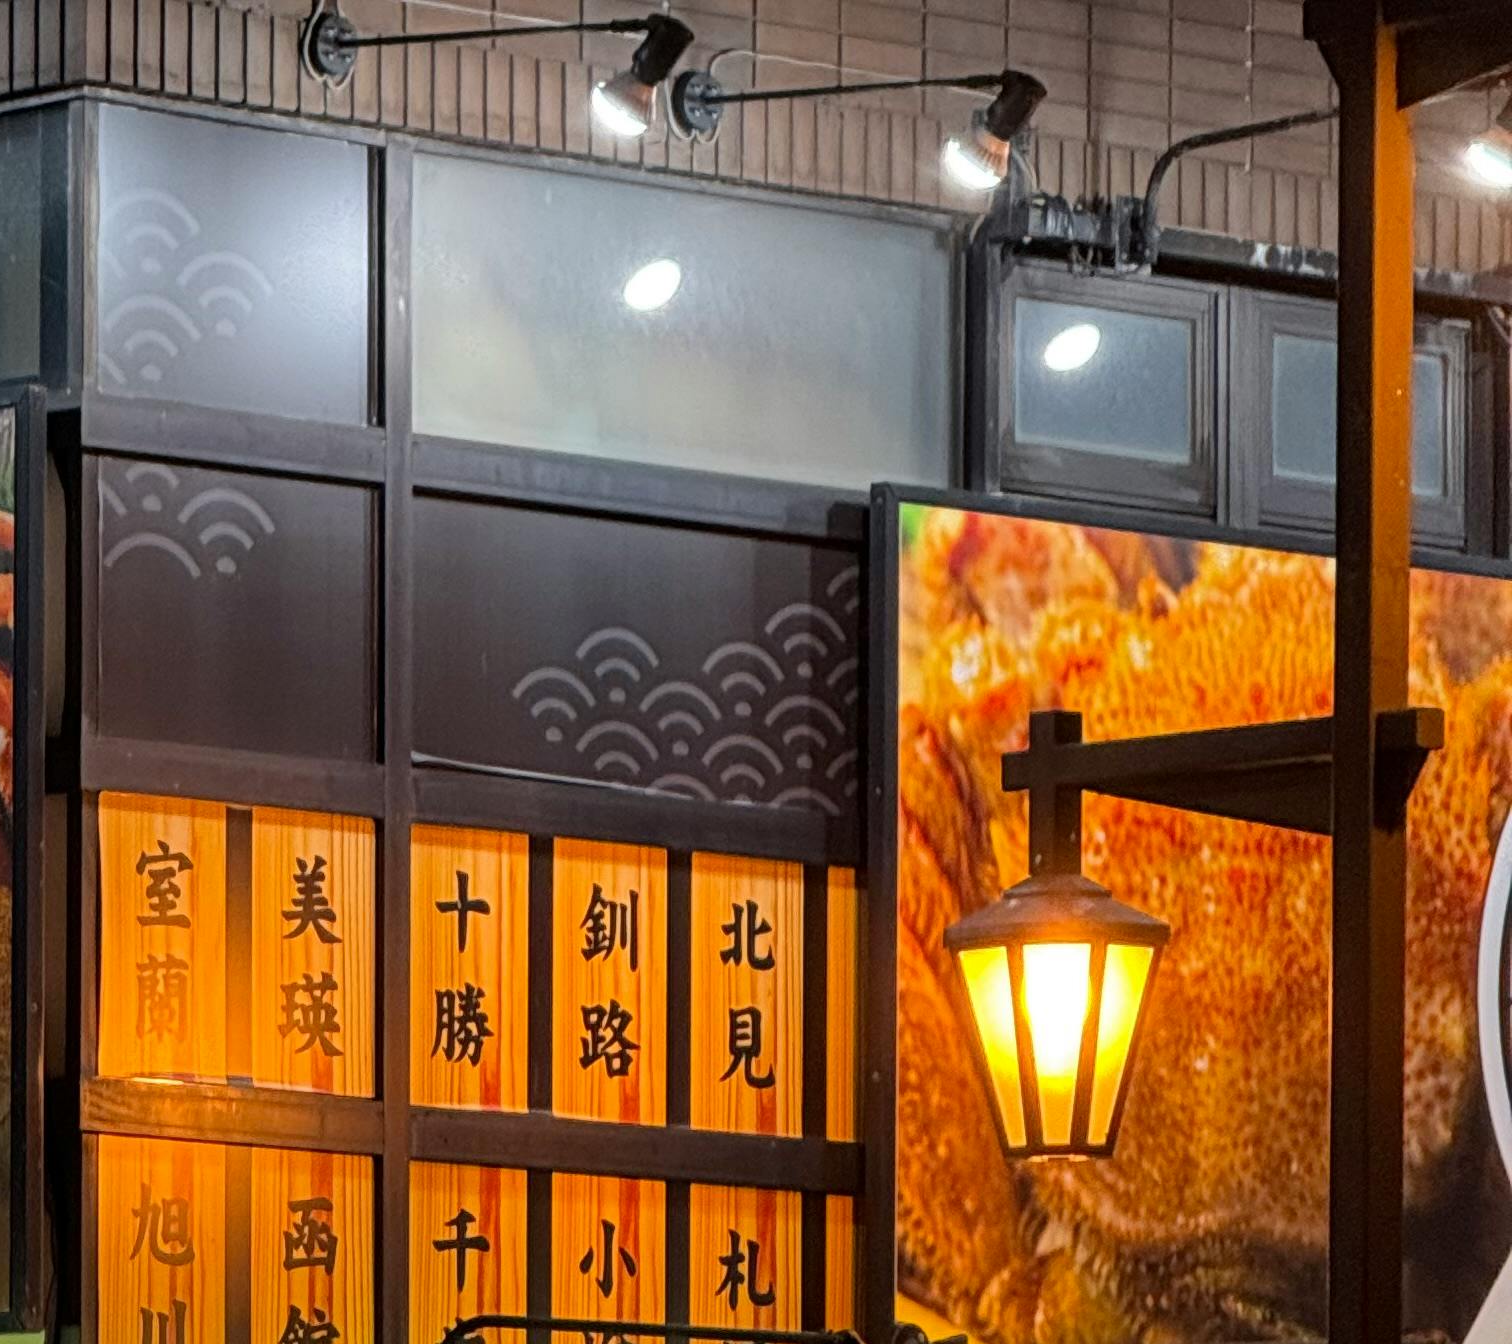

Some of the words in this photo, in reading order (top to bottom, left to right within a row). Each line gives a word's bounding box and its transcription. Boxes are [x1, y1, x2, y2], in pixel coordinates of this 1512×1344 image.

[135, 840, 194, 1044] 室蘭
[279, 855, 343, 1058] 美瑛
[430, 871, 494, 1068] 十勝
[579, 884, 641, 1079] 釧路
[720, 901, 775, 1089] 北見
